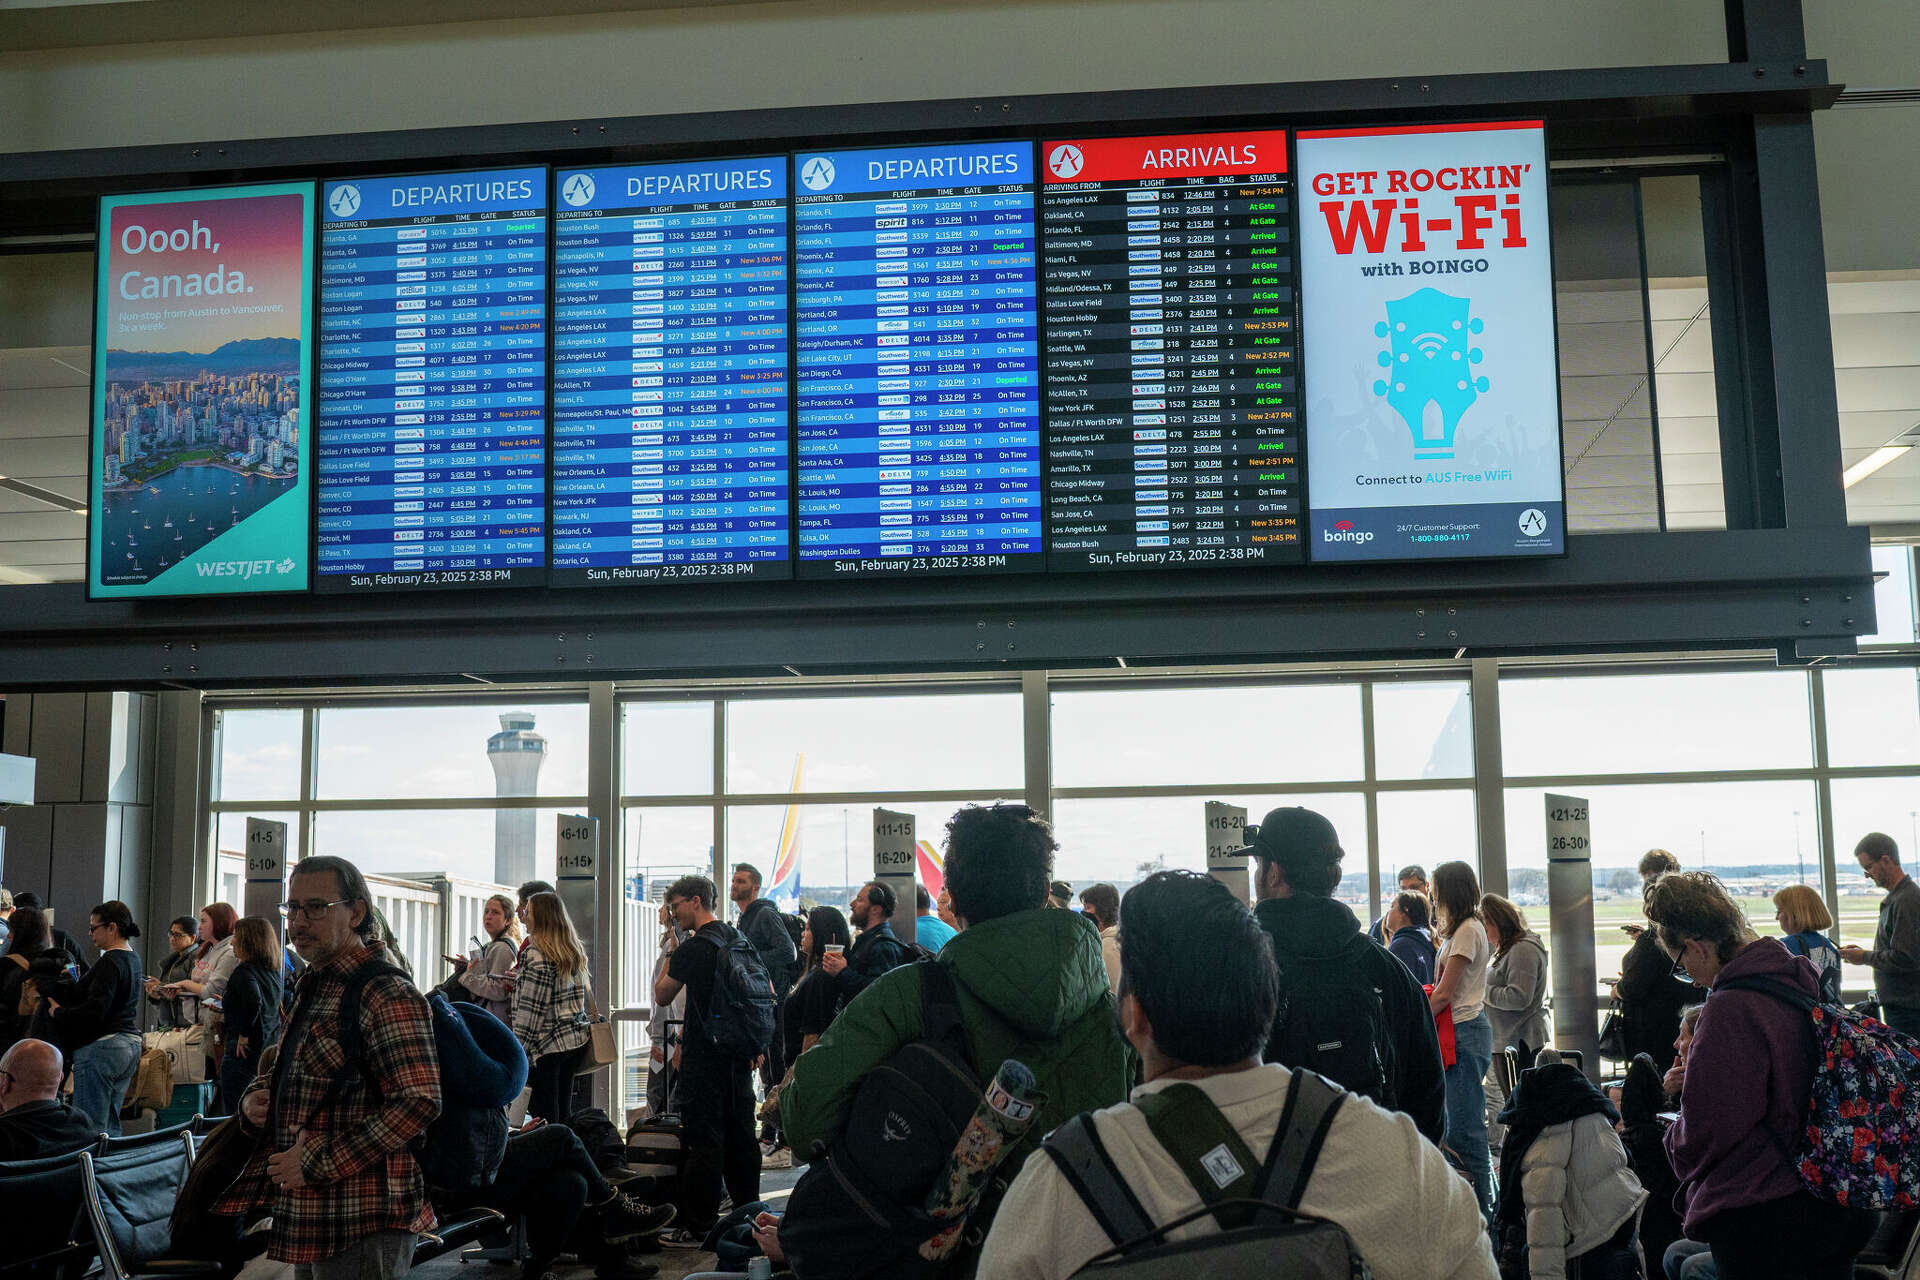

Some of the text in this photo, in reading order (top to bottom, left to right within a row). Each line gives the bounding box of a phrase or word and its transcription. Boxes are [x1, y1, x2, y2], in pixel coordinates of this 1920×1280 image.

[1142, 145, 1256, 169] ARRIVALS
[868, 154, 1018, 181] DEPARTURES
[627, 169, 772, 197] DEPARTURES
[1044, 183, 1078, 191] ARRIVING
[1250, 174, 1277, 182] STATUS
[1312, 164, 1531, 196] GET ROCKIN'
[392, 180, 532, 207] DEPARTURES
[796, 195, 833, 204] DEPARTING
[1055, 197, 1082, 206] Angeles
[557, 210, 593, 219] DEPARTING
[323, 220, 358, 229] DEPARTING
[796, 223, 823, 232] Orlando,
[876, 218, 905, 228] spirit
[936, 216, 949, 224] 5:12
[950, 216, 962, 224] PM
[1320, 193, 1527, 255] Wi-Fi
[122, 220, 221, 254] Oooh,
[1361, 259, 1489, 277] with BOINGO
[120, 264, 253, 300] Canada.
[120, 311, 161, 321] Non-stop
[164, 309, 186, 318] from
[188, 308, 218, 318] Austin
[220, 307, 230, 315] to
[1356, 470, 1512, 486] Connect to AUS Free WiFi
[553, 527, 581, 536] Oakland,
[583, 527, 592, 535] CA
[633, 524, 660, 532] Southwest
[668, 523, 684, 531] 3425
[1324, 529, 1373, 544] boingo
[1410, 534, 1470, 542] 1-800-880-4117
[835, 555, 1005, 573] Sun, February 23, 2025 2:38 PM
[1089, 548, 1264, 565] Sun, February 23, 2025 2:38 PM
[196, 559, 275, 580] WESTJET
[319, 563, 342, 573] Houston
[345, 562, 365, 572] Hobby
[394, 561, 422, 569] Southwest
[428, 559, 444, 567] 2693
[588, 563, 753, 581] Sun, February 23, 2025 2:38 PM
[351, 570, 510, 588] Sun, February 23, 2025 2:38 PM
[1557, 808, 1587, 821] 21-25
[882, 823, 911, 836] 11-15
[1215, 816, 1245, 829] 16-20
[256, 832, 272, 843] 1-5
[566, 828, 588, 840] 6-10
[1552, 836, 1584, 849] 26-30
[250, 858, 271, 870] 6-10
[560, 856, 587, 868] 11-15
[877, 851, 906, 864] 16-20
